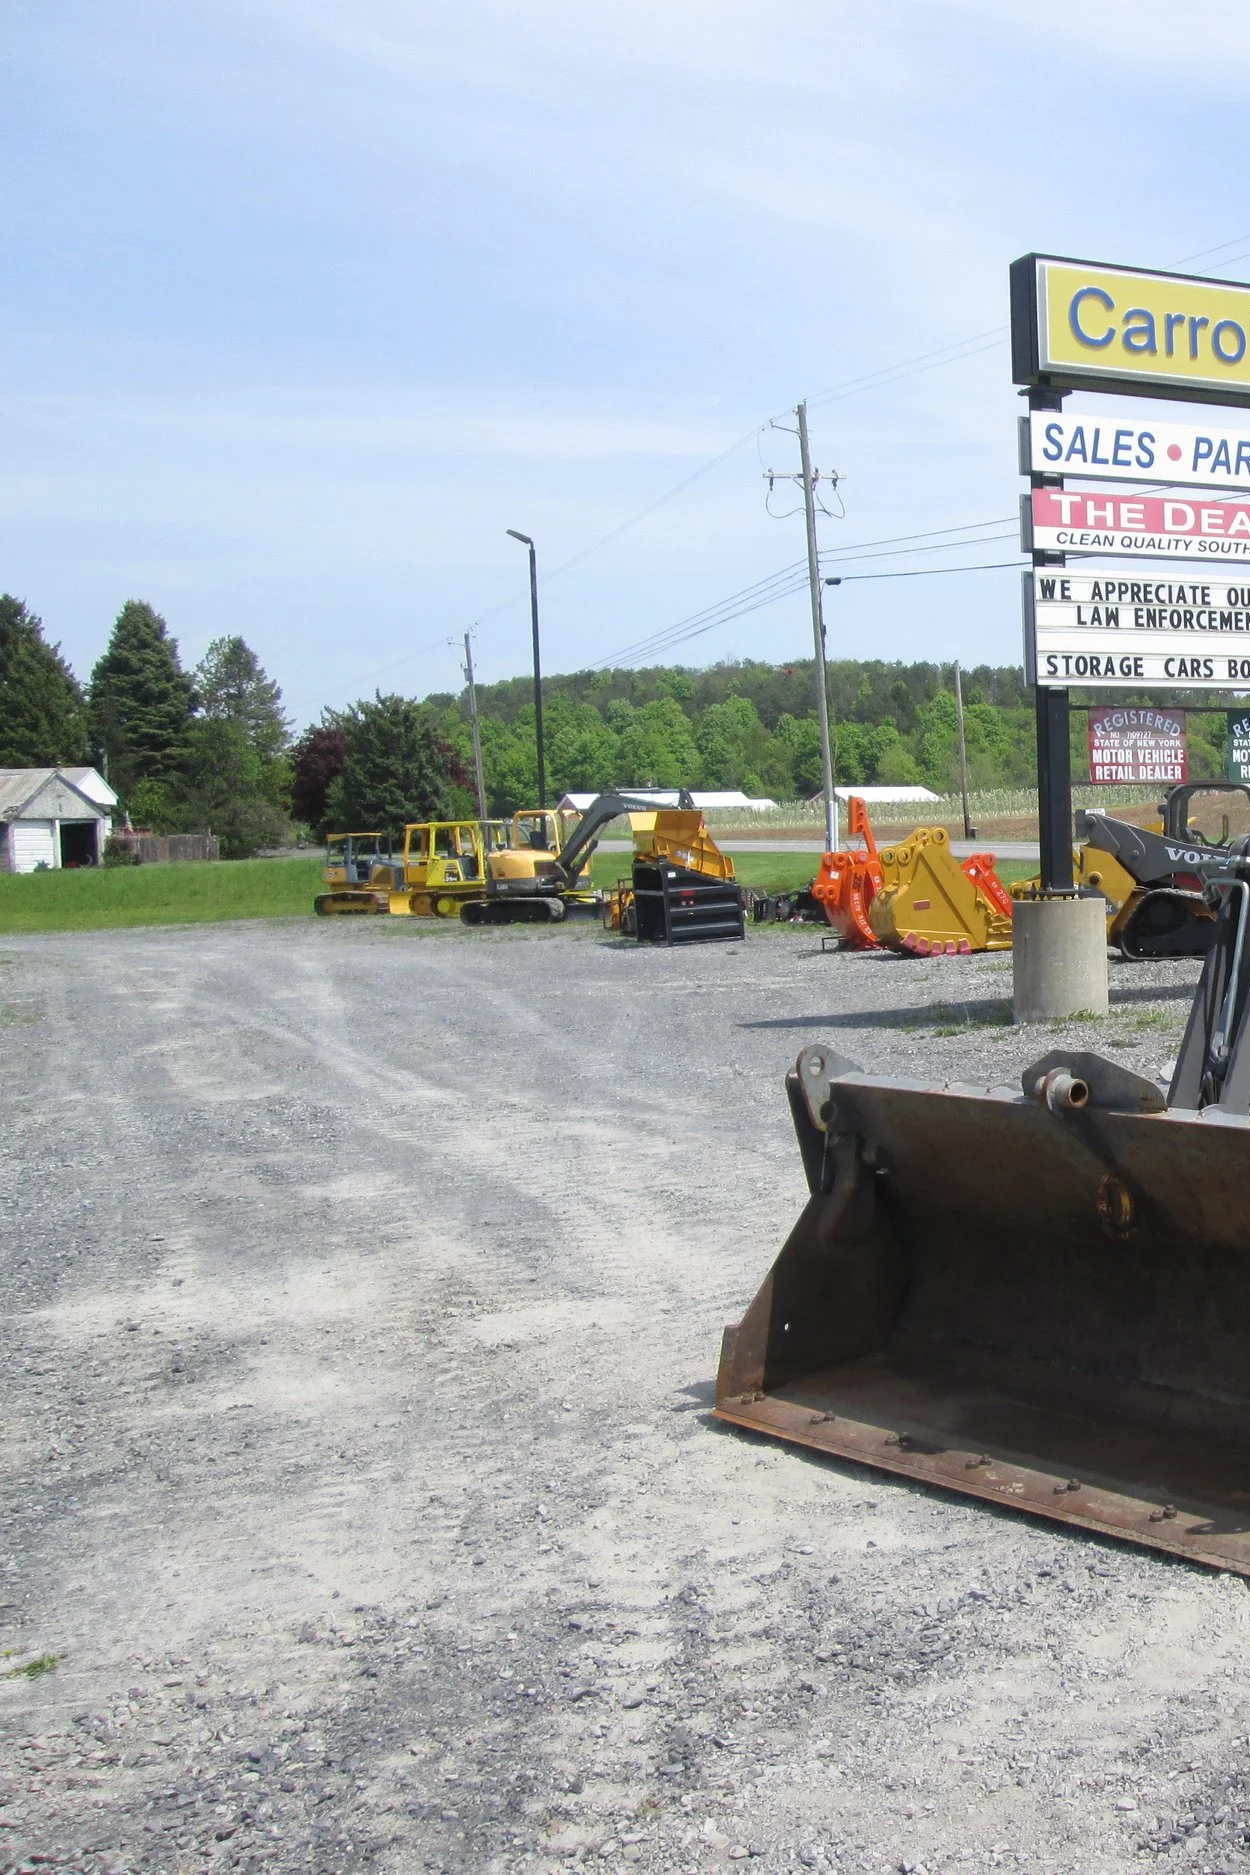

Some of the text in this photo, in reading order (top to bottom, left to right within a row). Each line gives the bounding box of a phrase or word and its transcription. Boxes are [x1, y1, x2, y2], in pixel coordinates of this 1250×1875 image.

[1042, 422, 1156, 469] SALES
[1047, 494, 1146, 529] THE
[1056, 531, 1115, 548] CLEAN
[1120, 535, 1193, 553] QUALITY
[1040, 578, 1071, 600] WE
[1091, 581, 1211, 606] APPRECIATE
[1076, 606, 1119, 628] LAW
[1046, 655, 1144, 677] STORAGE
[1164, 657, 1214, 678] CARS
[1093, 710, 1181, 737] REGISTERED
[1094, 739, 1181, 747] STATE OF NEW YORK
[1093, 749, 1184, 763] MOTOR VEHICLE
[1096, 765, 1182, 780] RETAIL DEALER
[997, 889, 1009, 905] 270
